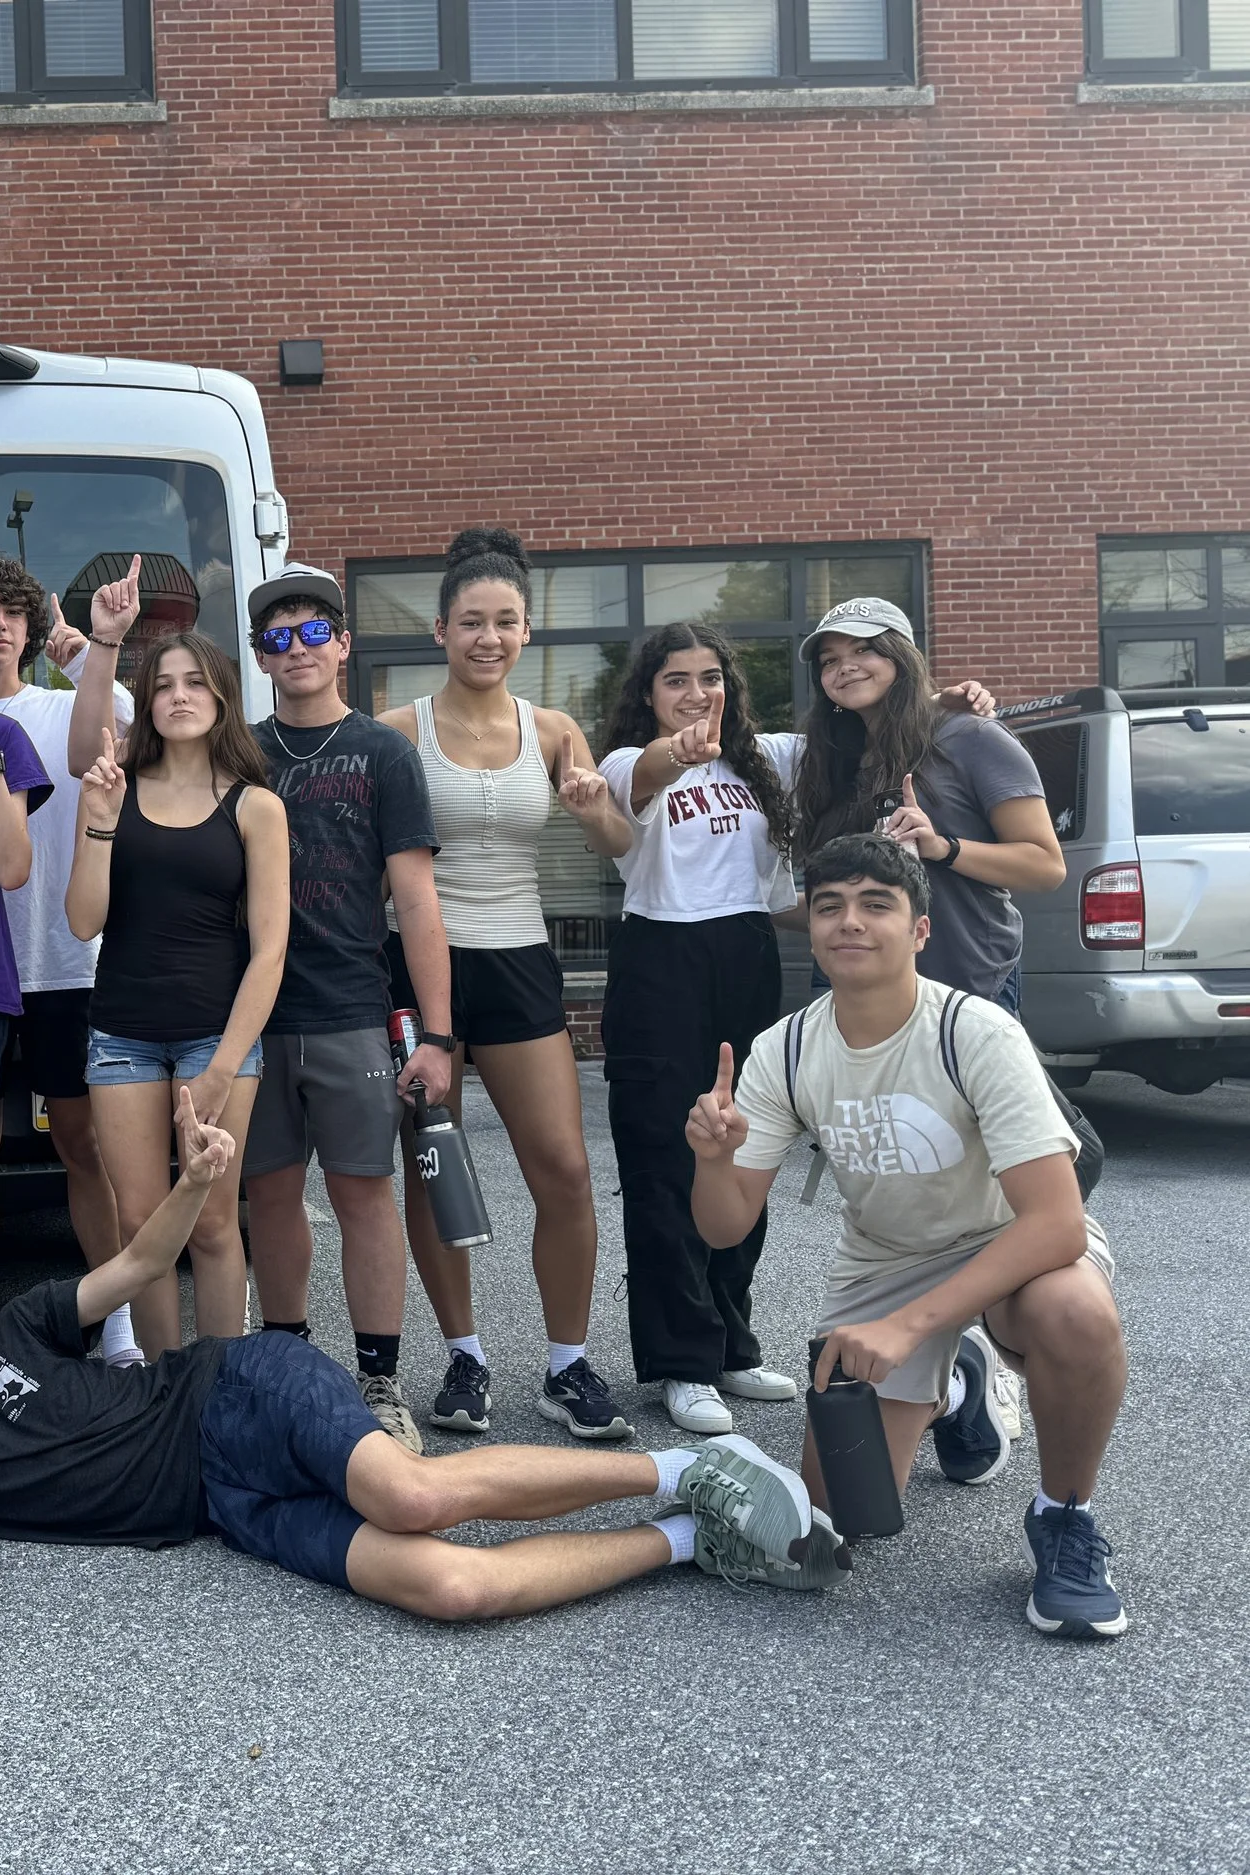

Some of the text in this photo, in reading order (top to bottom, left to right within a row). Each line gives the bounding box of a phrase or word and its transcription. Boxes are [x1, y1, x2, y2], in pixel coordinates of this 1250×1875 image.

[994, 694, 1065, 718] FINDER
[667, 785, 711, 828] NEW
[709, 813, 741, 836] CITY
[834, 1095, 893, 1127] THE
[817, 1120, 896, 1153] ORTH
[826, 1148, 902, 1176] FACE
